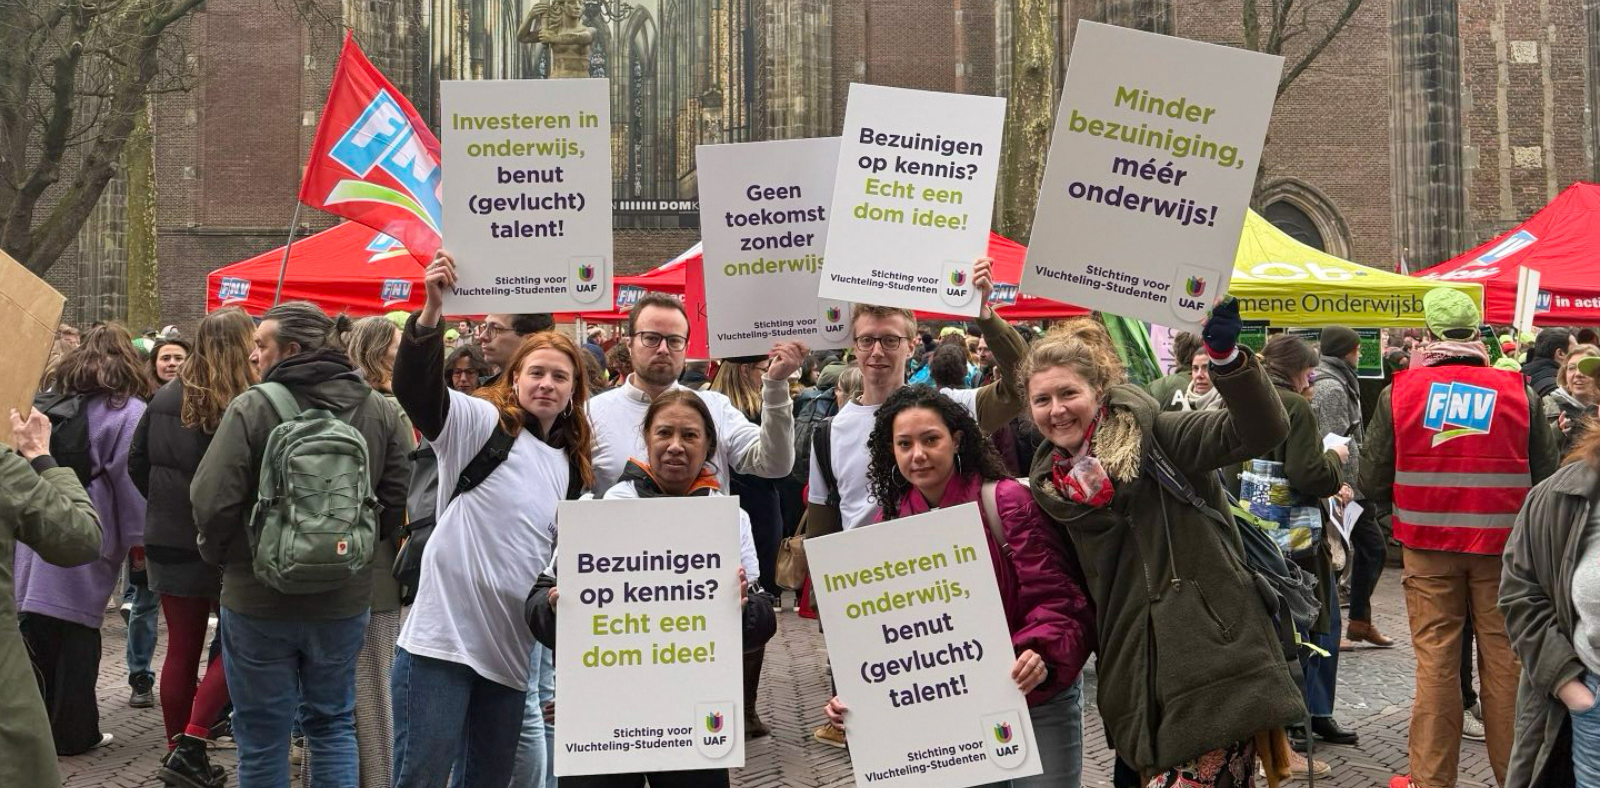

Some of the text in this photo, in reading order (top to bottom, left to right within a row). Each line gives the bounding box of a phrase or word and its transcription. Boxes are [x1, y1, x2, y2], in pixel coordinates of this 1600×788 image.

[1114, 85, 1215, 124] Minder
[453, 111, 598, 130] Investeren in
[467, 138, 585, 158] onderwijs,
[859, 127, 983, 156] Bezuinigen
[1069, 109, 1245, 169] bezuiniging,
[497, 167, 564, 184] benut
[858, 155, 978, 180] op kennis?
[1112, 156, 1187, 186] méér
[746, 185, 801, 201] Geen
[865, 178, 963, 204] Echt een
[469, 192, 585, 215] (gevlucht)
[1068, 181, 1218, 227] onderwijs!
[725, 205, 826, 227] toekomst
[854, 202, 968, 230] dom idee!
[491, 220, 564, 238] talent!
[740, 231, 814, 251] zonder
[724, 254, 825, 277] onderwijs
[495, 276, 567, 285] Stichting voor
[830, 273, 937, 294] Vluchteling-Studenten
[871, 269, 939, 285] Stichting voor
[1035, 265, 1167, 304] Vluchteling-Studenten
[1086, 264, 1170, 292] Stichting voor
[452, 285, 567, 297] Vluchteling-Studenten
[576, 284, 597, 293] UAF
[946, 287, 967, 297] UAF
[990, 285, 1019, 300] FNV
[1178, 298, 1205, 311] UAF
[1555, 295, 1570, 307] in
[717, 327, 818, 341] Vluchteling-Studenten
[754, 318, 817, 329] Stichting voor
[825, 324, 844, 333] UAF
[1429, 393, 1494, 420] FNV
[577, 550, 721, 574] Bezuinigen
[824, 545, 977, 593] Investeren in
[580, 579, 719, 608] op kennis?
[846, 579, 970, 619] onderwijs,
[592, 613, 706, 635] Echt een
[882, 612, 954, 644] benut
[582, 642, 715, 667] dom idee!
[860, 639, 984, 683] (gevlucht)
[889, 675, 969, 708] talent!
[613, 726, 693, 739] Stichting voor
[703, 736, 727, 746] UAF
[565, 738, 693, 753] Vluchteling-Studenten
[907, 740, 984, 762] Stichting voor
[996, 744, 1019, 757] UAF
[865, 752, 987, 783] Vluchteling-Studenten
